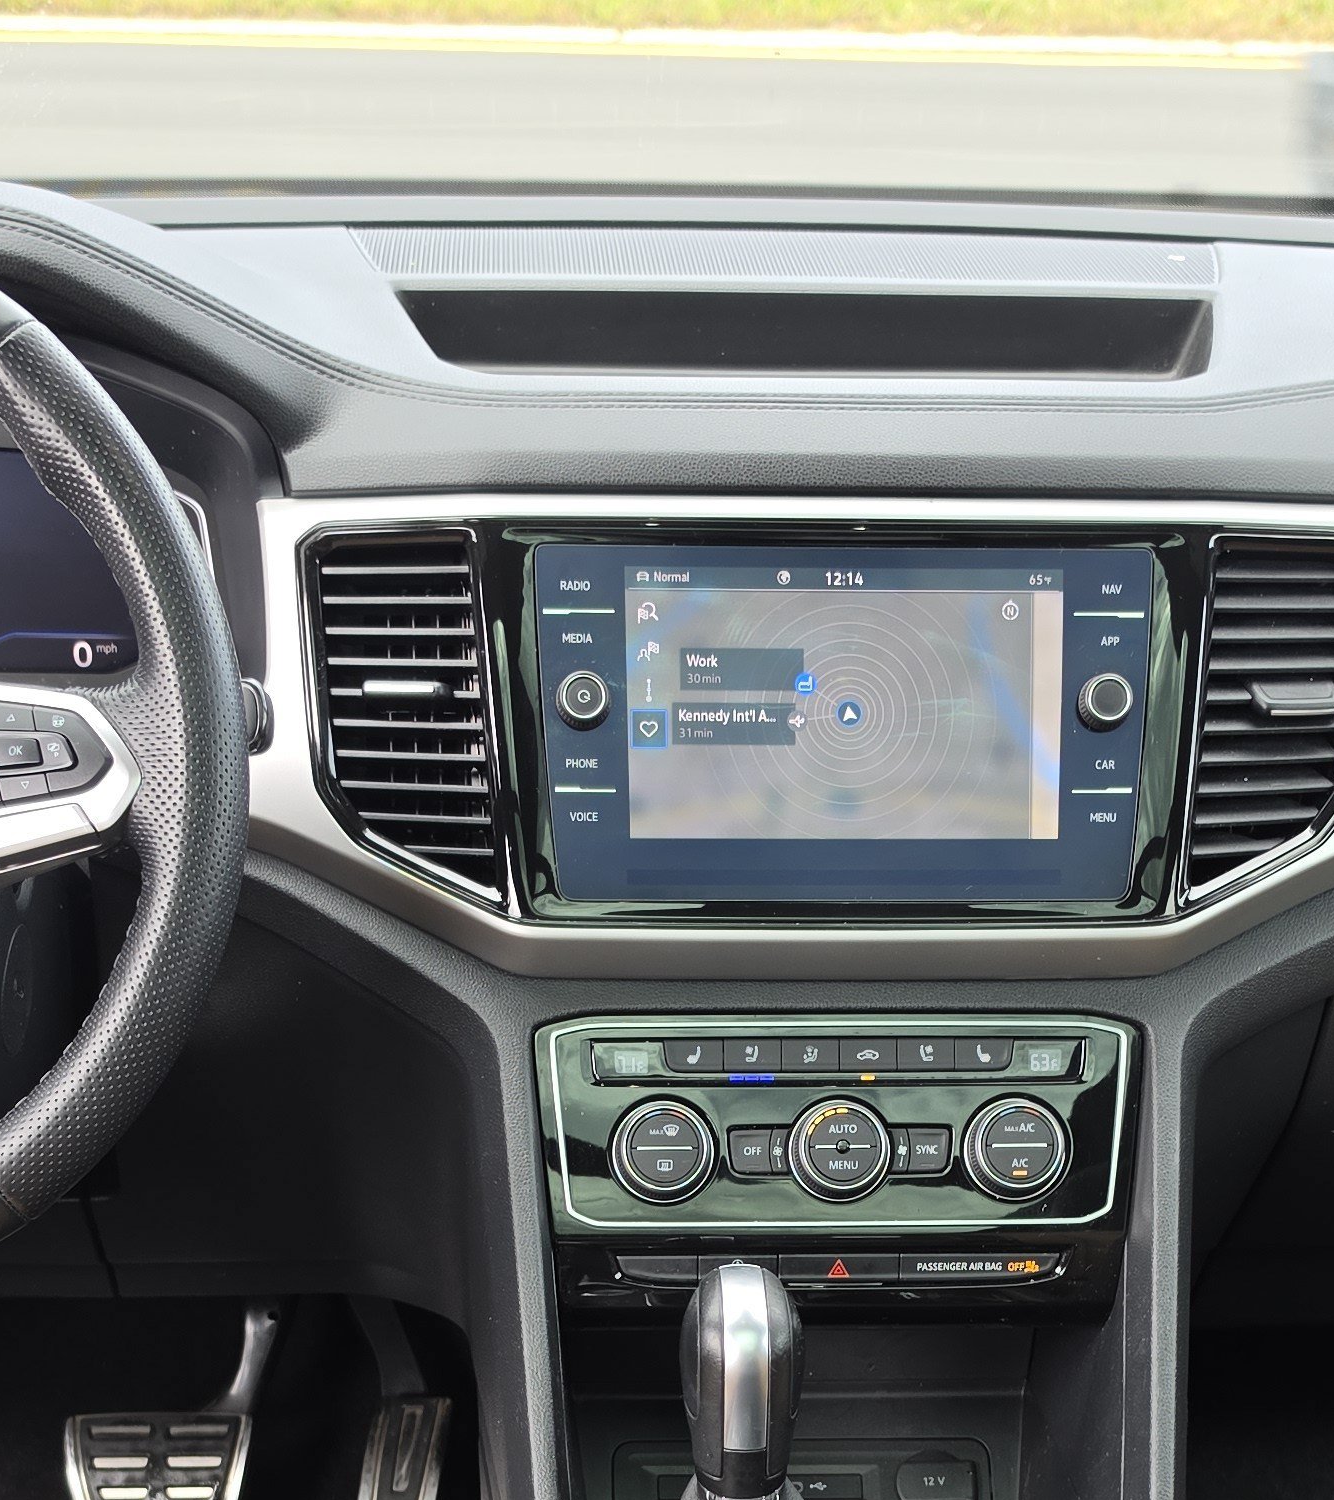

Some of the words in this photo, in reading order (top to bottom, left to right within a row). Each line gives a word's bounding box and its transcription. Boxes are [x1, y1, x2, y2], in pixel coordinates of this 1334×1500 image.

[653, 571, 690, 583] Normal
[825, 571, 864, 587] 12:14
[559, 580, 591, 592] RADIO
[1101, 584, 1123, 595] NAV
[562, 633, 593, 644] MEDIA
[1100, 636, 1120, 647] APP
[72, 640, 94, 668] 0
[96, 643, 118, 655] mph
[686, 653, 719, 668] Work
[678, 708, 730, 726] Kennedy
[8, 745, 24, 756] OK
[565, 758, 599, 769] PHONE
[1095, 760, 1115, 770] CAR
[569, 811, 599, 823] VOICE
[1090, 812, 1117, 823] MENU
[828, 1124, 858, 1134] AUTO
[1019, 1122, 1036, 1133] A/C
[743, 1146, 762, 1156] OFF
[915, 1144, 939, 1155] SYNC
[828, 1160, 859, 1170] MENU
[1011, 1158, 1028, 1168] A/C
[916, 1262, 967, 1272] PASSENGER
[968, 1262, 984, 1271] AIR
[984, 1262, 1003, 1271] BAG
[1007, 1261, 1025, 1272] OFF
[923, 1476, 935, 1487] 12
[937, 1476, 946, 1486] V
